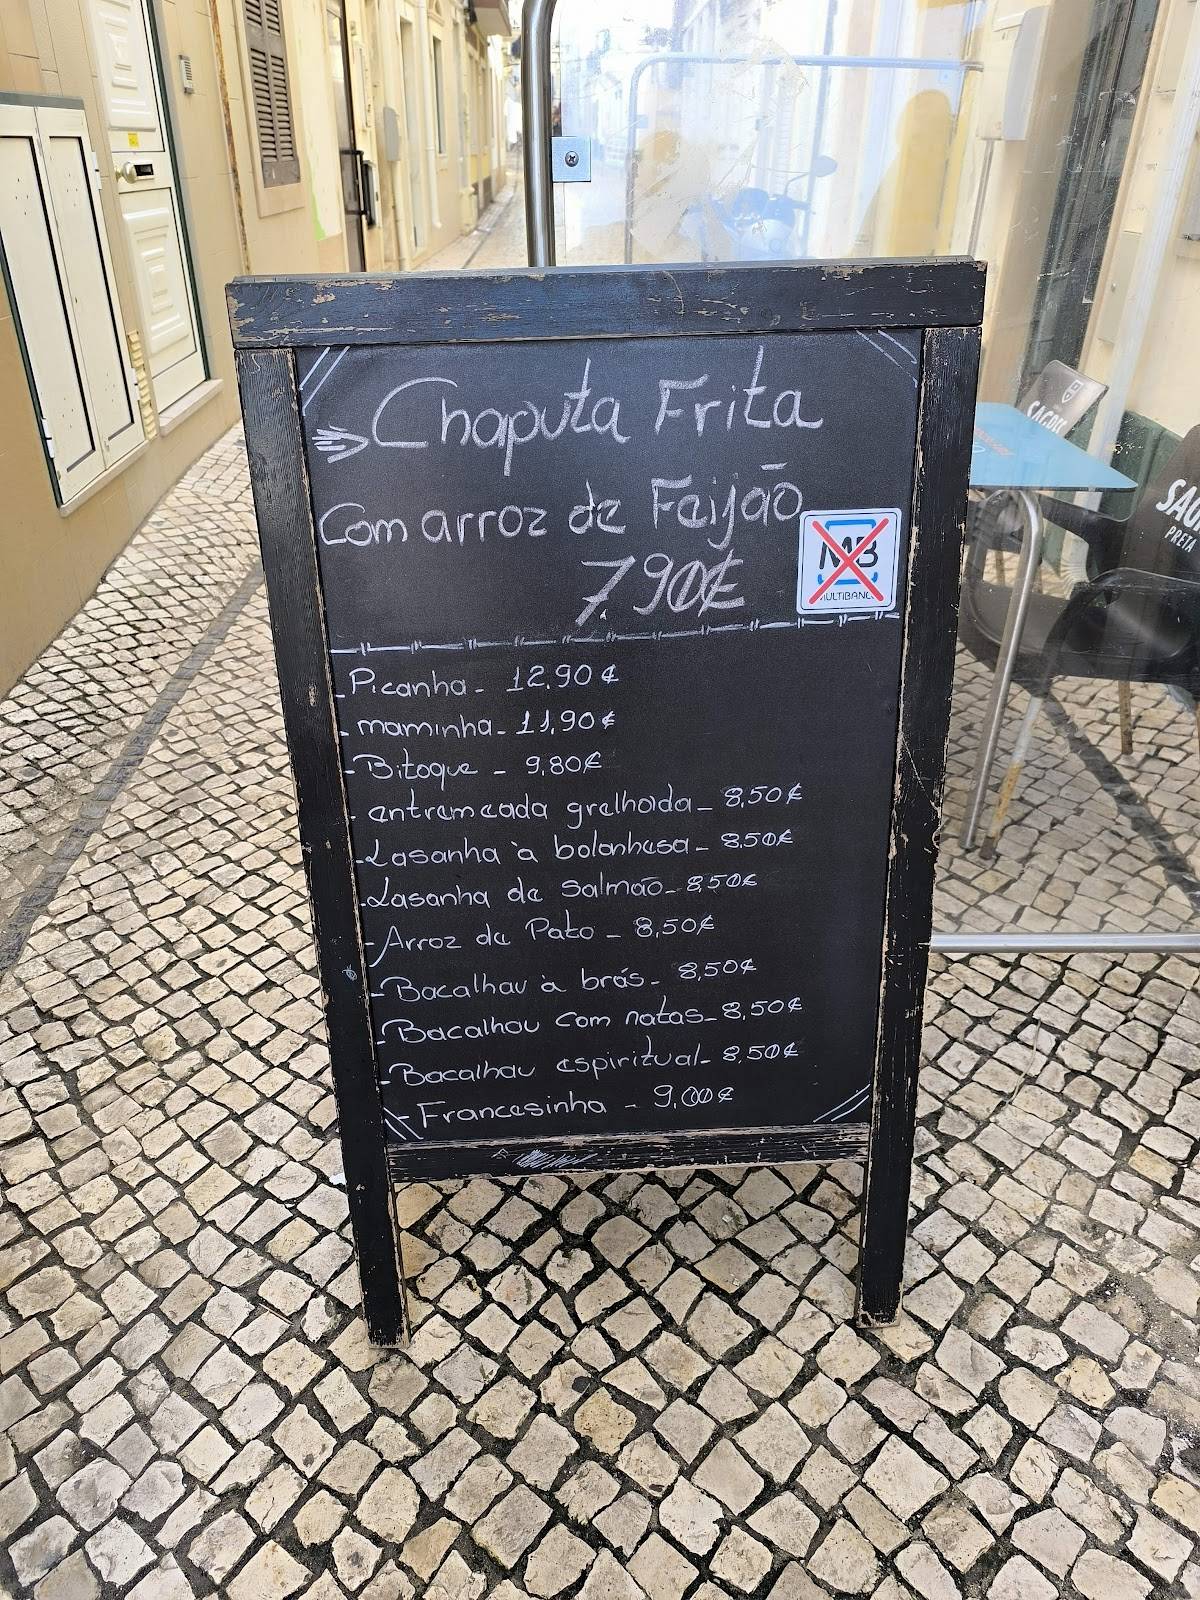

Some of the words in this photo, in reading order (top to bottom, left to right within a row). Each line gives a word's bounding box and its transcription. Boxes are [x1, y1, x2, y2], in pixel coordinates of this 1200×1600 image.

[372, 358, 631, 476] Chaputa
[655, 345, 824, 437] Frita
[1027, 401, 1069, 434] SAGR
[319, 503, 408, 545] Com
[422, 505, 547, 545] arroz
[568, 480, 626, 534] de
[651, 462, 803, 549] Feijão
[819, 537, 879, 570] MB
[1164, 525, 1198, 553] PRETA
[820, 591, 876, 601] ULTIBANC
[349, 667, 467, 698] Picanha
[357, 714, 492, 738] maminha
[353, 748, 478, 791] Bitoque
[567, 783, 692, 830] grelhada
[365, 837, 501, 867] Lasanha
[367, 877, 491, 909] Lasanha
[508, 877, 544, 904] de
[369, 925, 462, 967] Arroz
[476, 923, 511, 945] de
[525, 909, 595, 941] Pato
[380, 973, 528, 1002] Bacalhau
[541, 974, 567, 993] à
[581, 968, 645, 990] brás
[382, 1016, 540, 1043] Bacalhau
[625, 995, 704, 1026] natas
[389, 1060, 537, 1087] Bacalhau
[556, 1035, 701, 1081] espiritual
[416, 1090, 608, 1128] Francesinha
